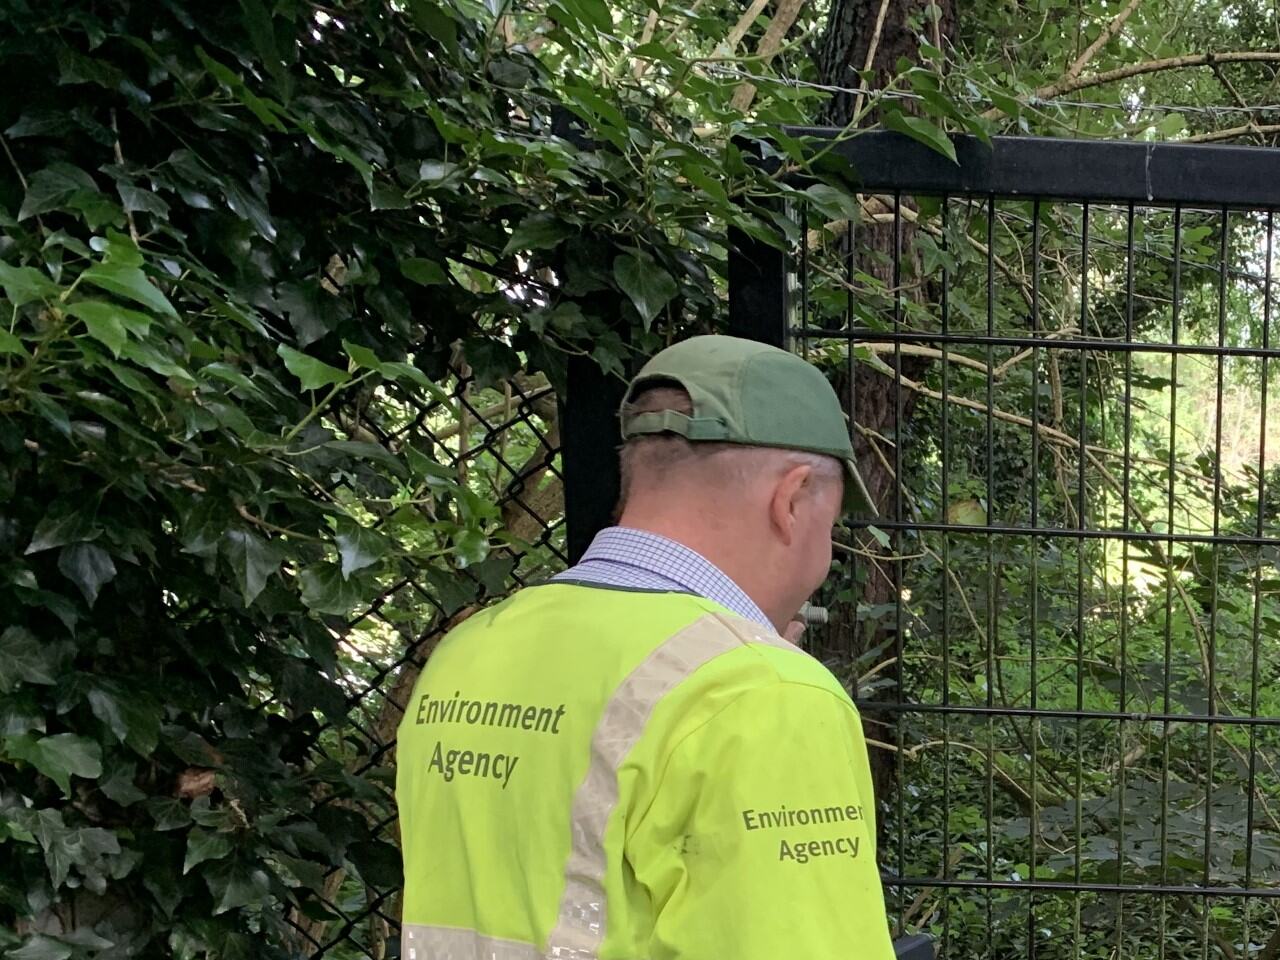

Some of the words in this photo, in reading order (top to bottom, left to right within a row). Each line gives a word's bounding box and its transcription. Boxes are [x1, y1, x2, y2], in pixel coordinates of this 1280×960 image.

[415, 690, 566, 734] Environment
[428, 741, 519, 789] Agency
[779, 836, 860, 864] Agency
